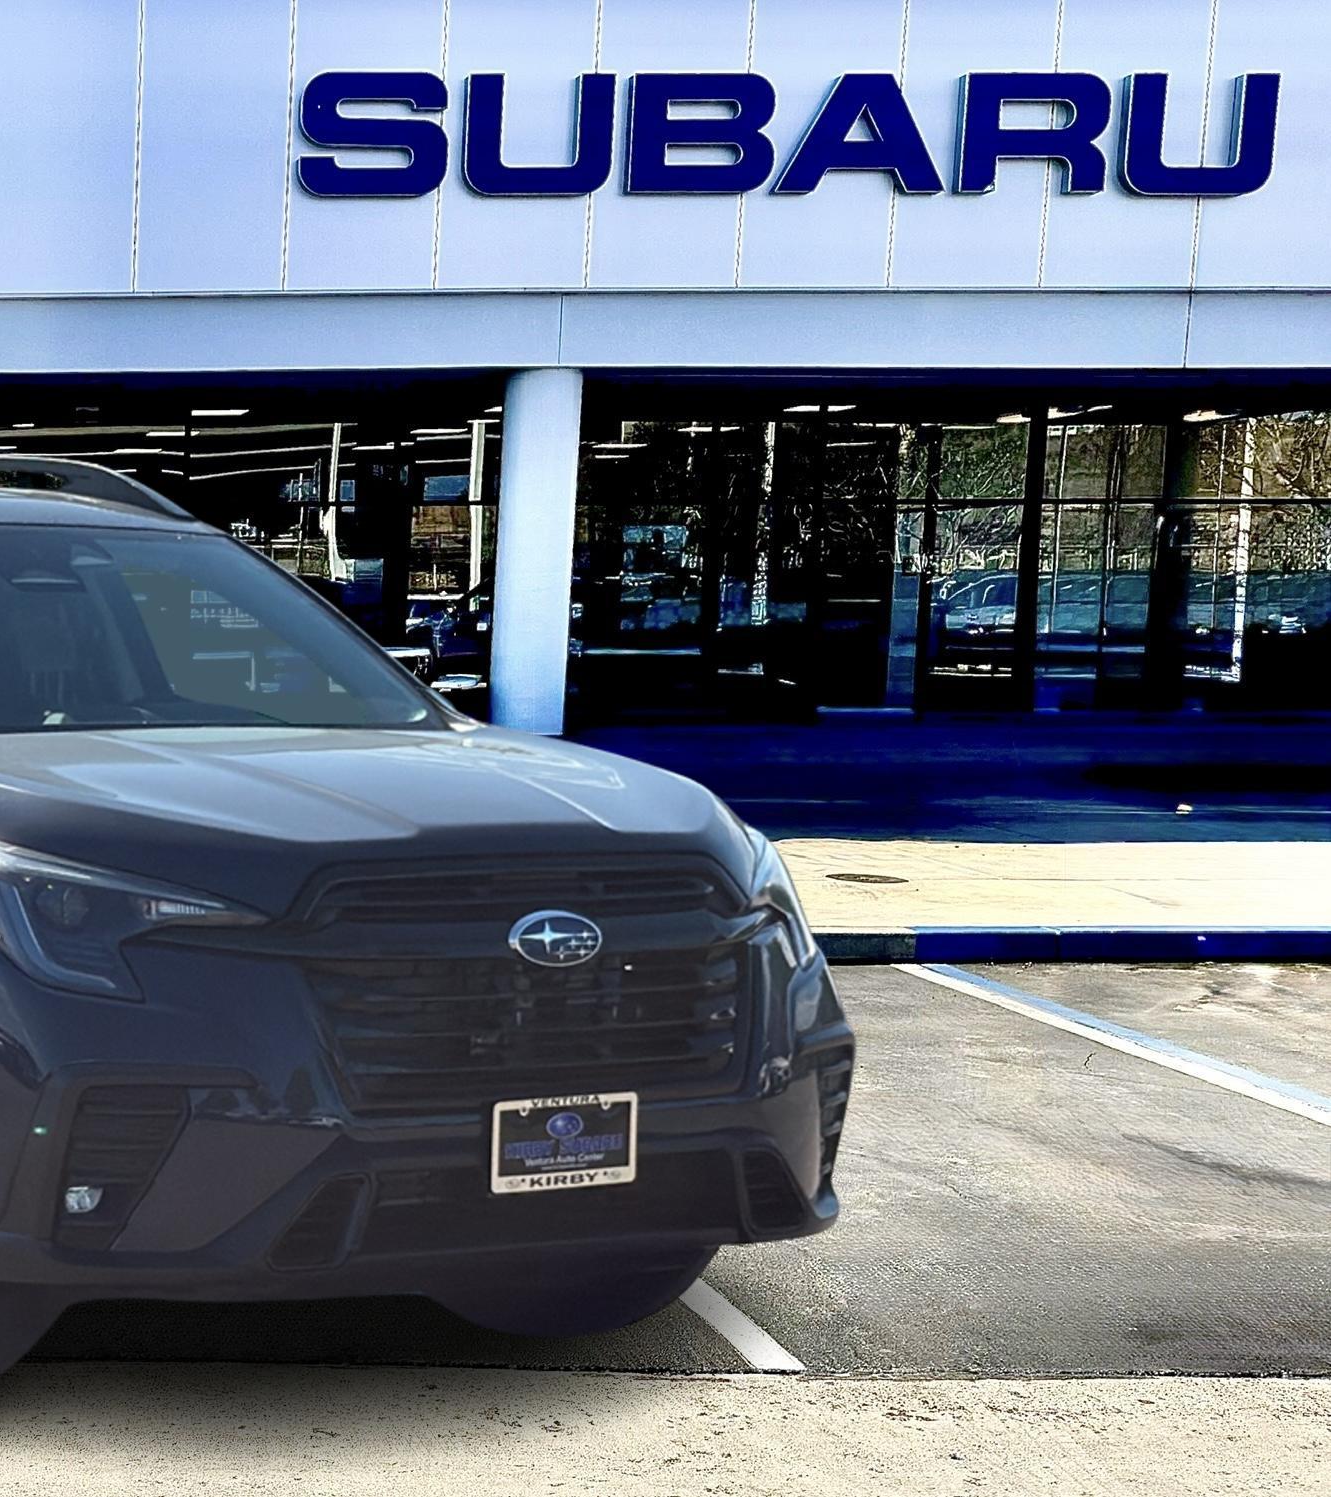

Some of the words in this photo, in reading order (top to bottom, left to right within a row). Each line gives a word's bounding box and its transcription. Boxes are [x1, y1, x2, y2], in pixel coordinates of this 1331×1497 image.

[297, 71, 1282, 198] SUBARU
[530, 1094, 602, 1108] VENTURA
[524, 1156, 555, 1167] Ventura
[556, 1154, 576, 1163] Auto
[577, 1152, 605, 1162] Center
[529, 1170, 599, 1188] KIRBY
